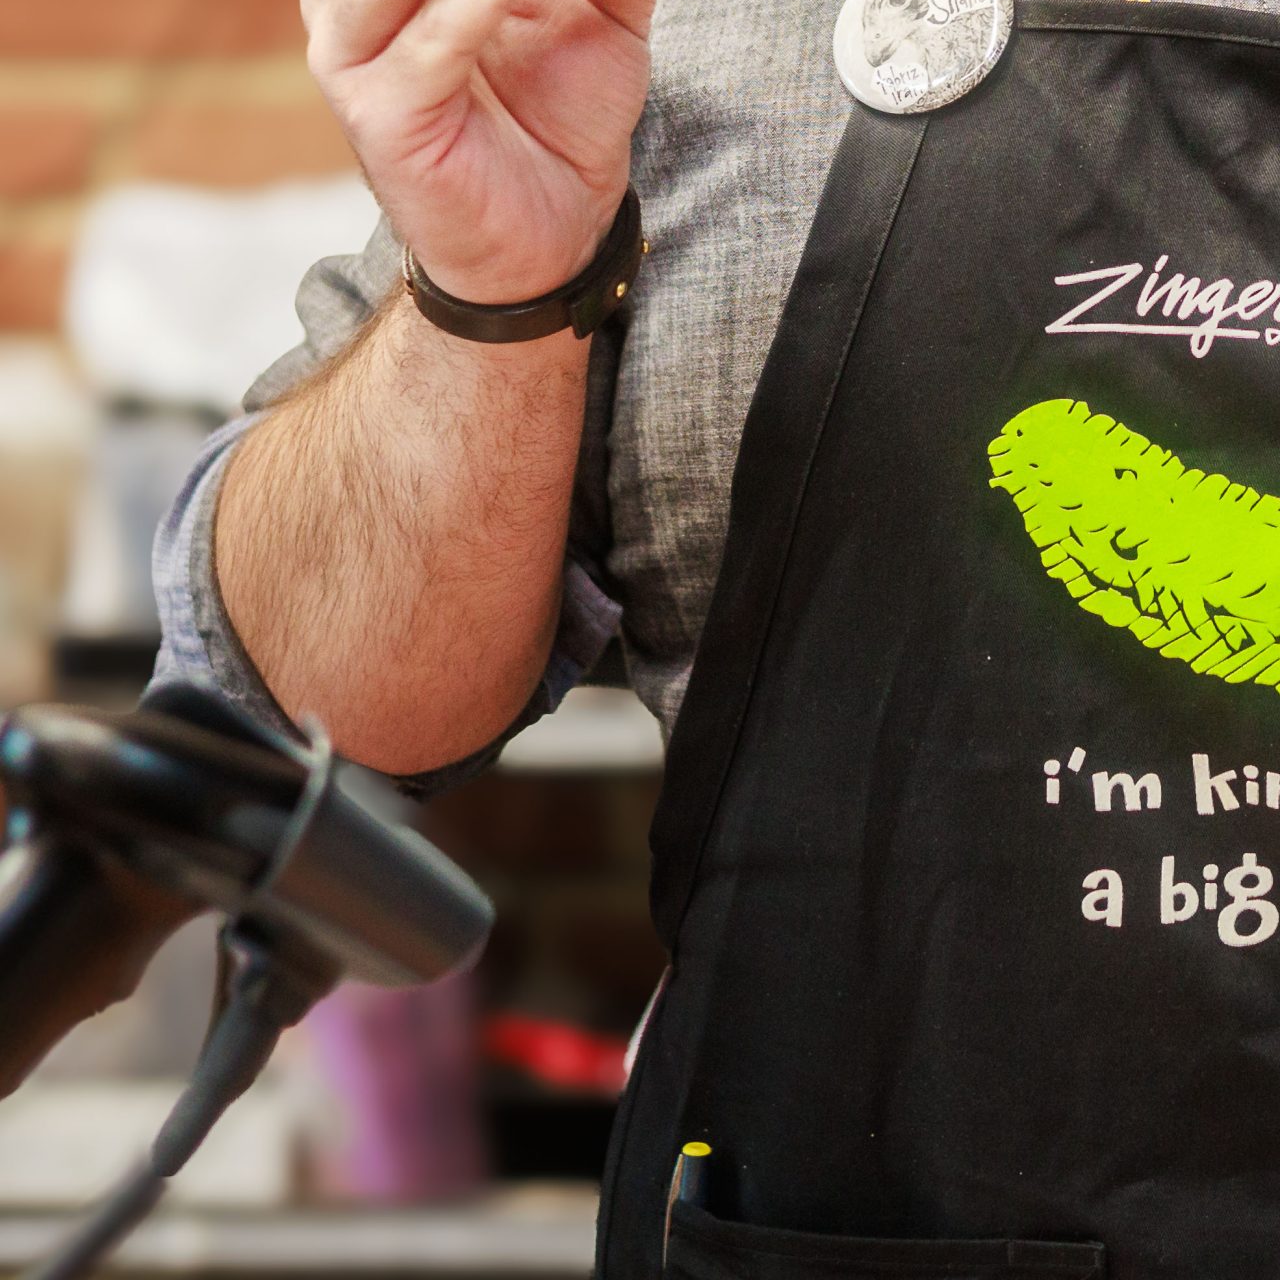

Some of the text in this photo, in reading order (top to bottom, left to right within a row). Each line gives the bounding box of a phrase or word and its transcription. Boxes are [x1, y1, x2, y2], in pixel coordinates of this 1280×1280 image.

[1043, 746, 1162, 812] i'm
[1081, 868, 1124, 928] a
[1160, 852, 1280, 947] big
